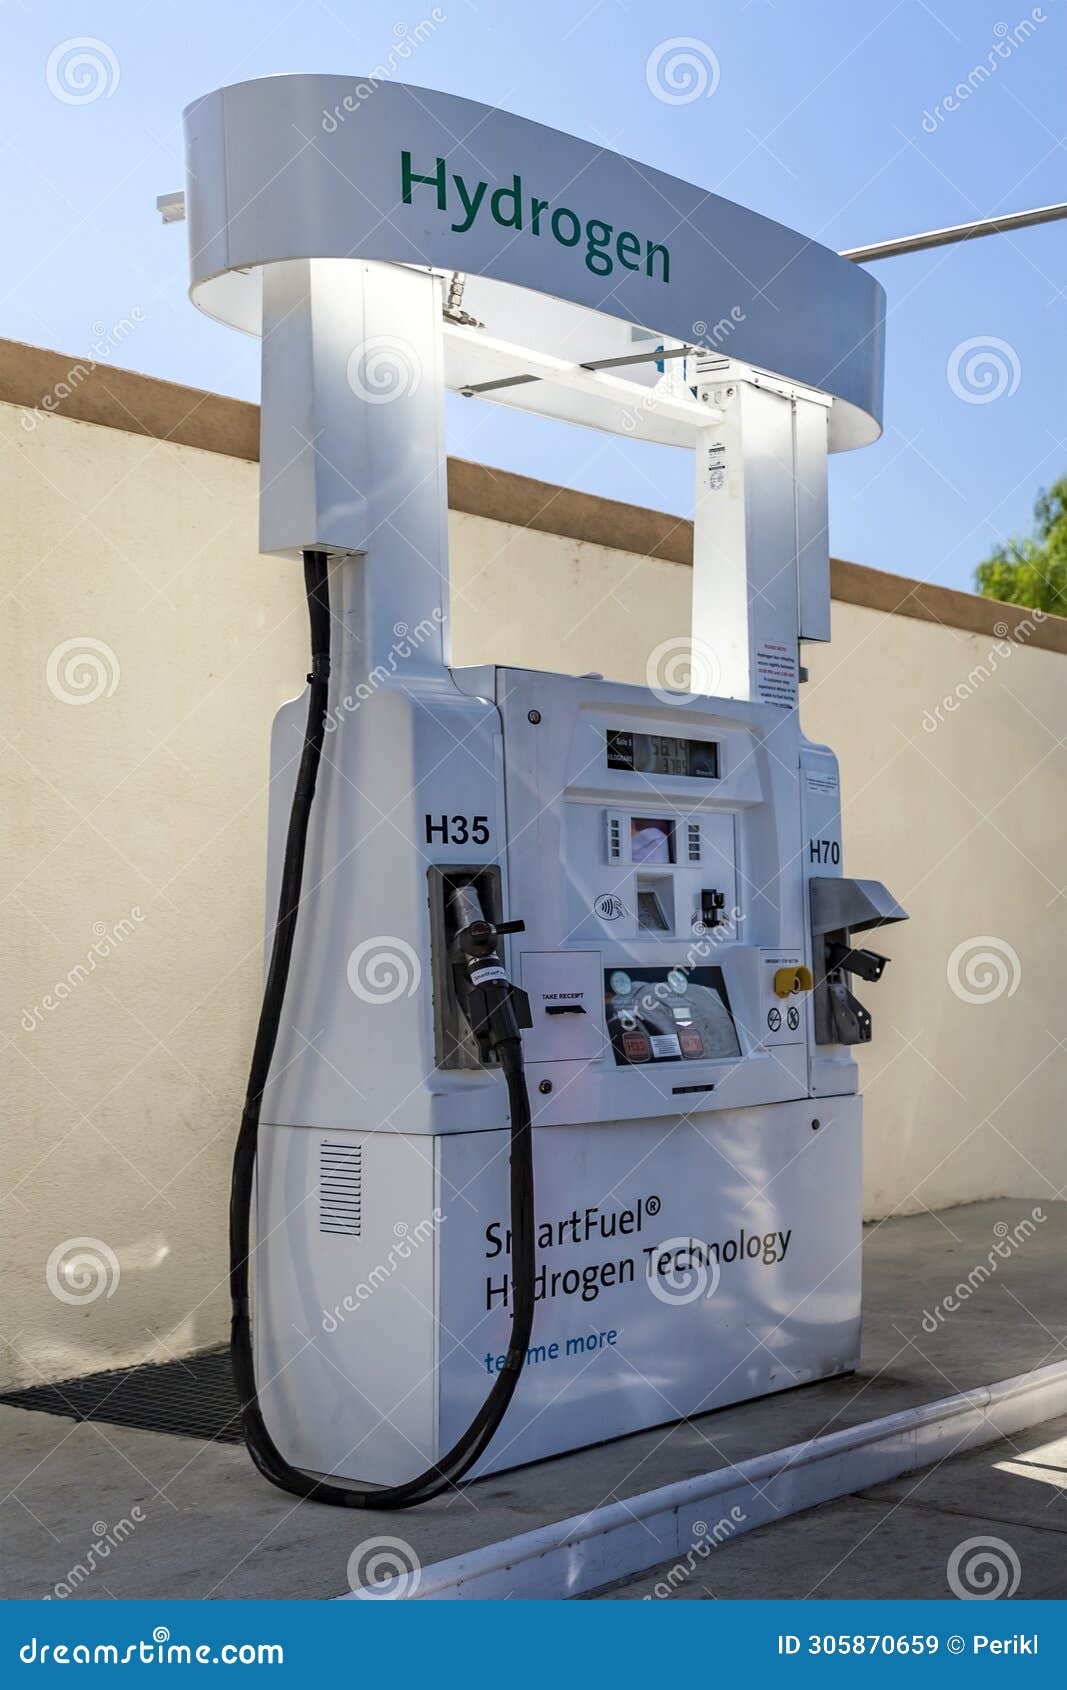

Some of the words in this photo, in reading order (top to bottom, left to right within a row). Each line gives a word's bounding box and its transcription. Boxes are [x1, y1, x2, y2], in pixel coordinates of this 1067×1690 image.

[400, 150, 671, 284] Hydrogen
[425, 814, 490, 845] H35
[809, 838, 840, 865] H70
[486, 1257, 634, 1318] Hdrogen
[643, 1228, 792, 1278] Technology
[527, 1341, 559, 1366] me
[566, 1329, 617, 1355] more
